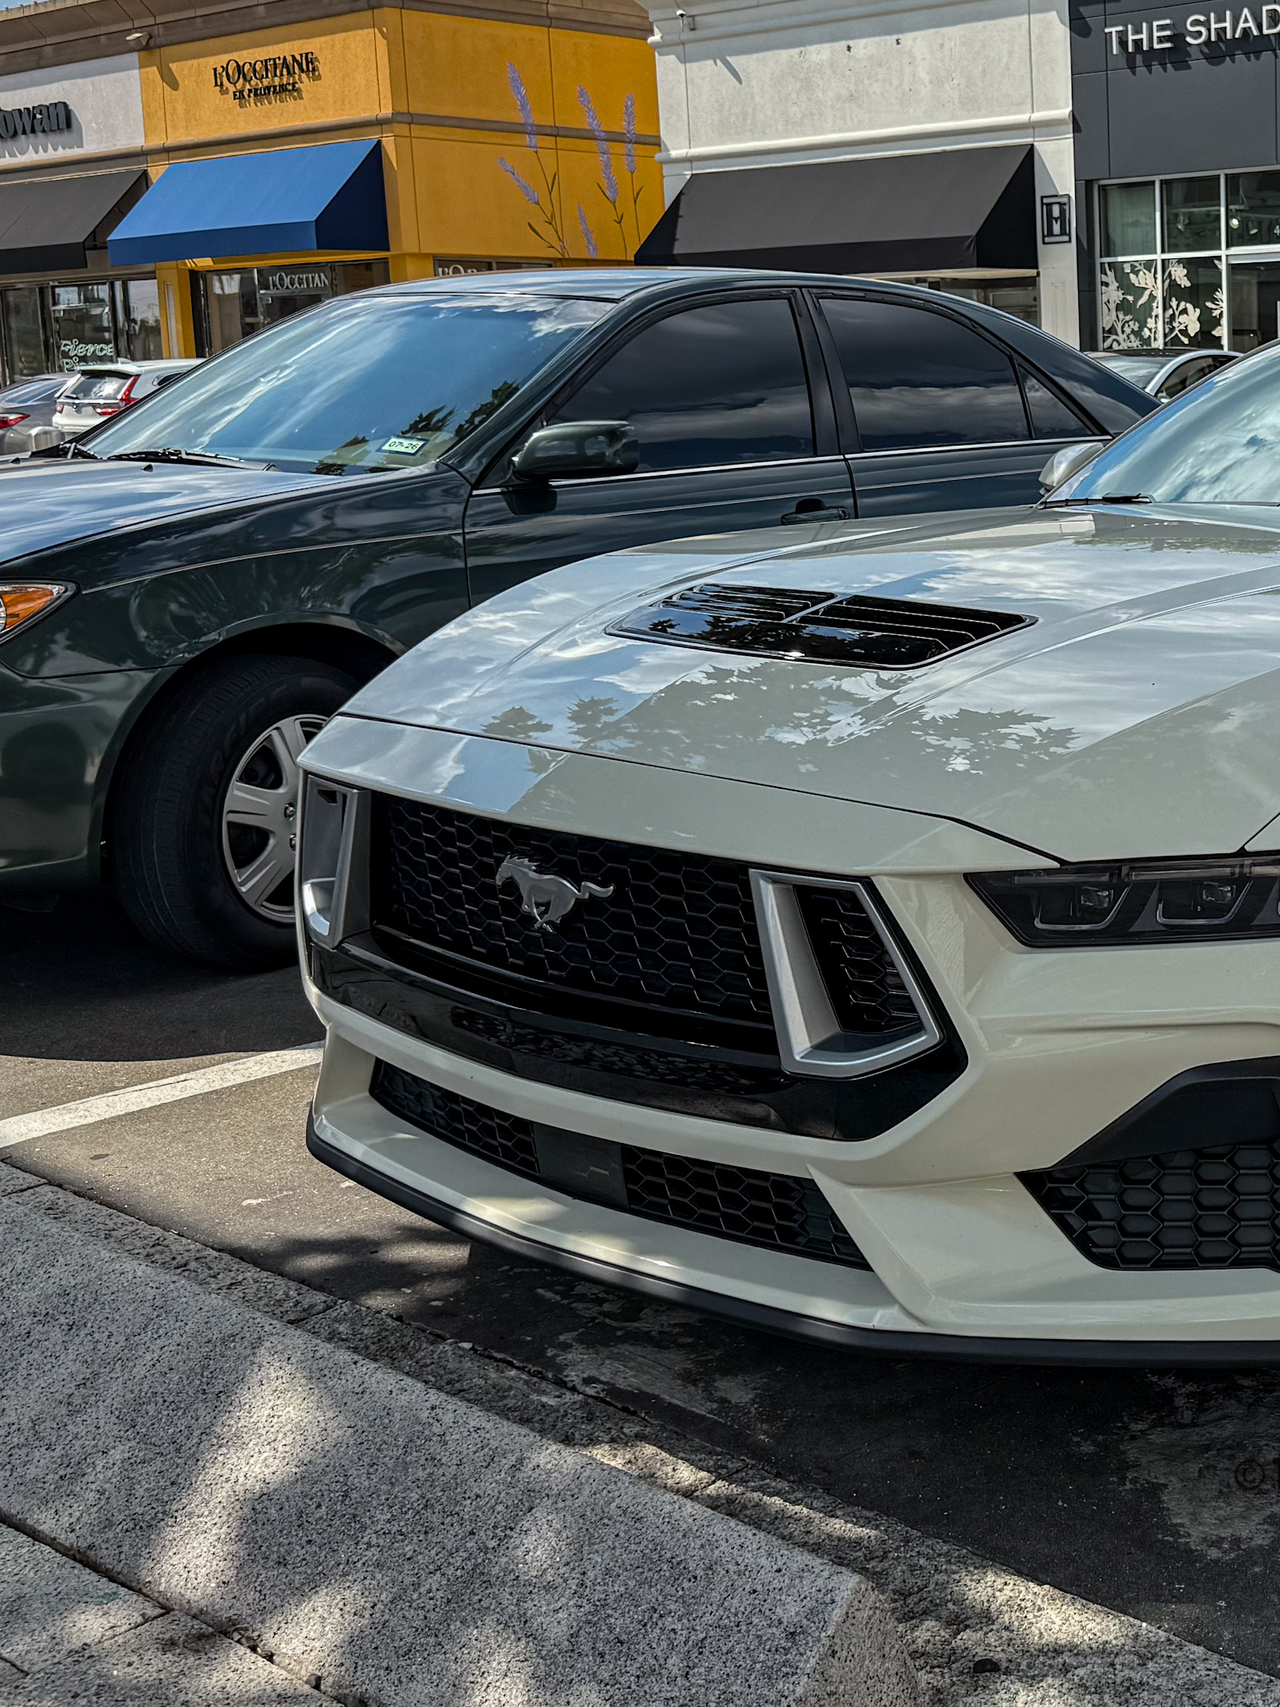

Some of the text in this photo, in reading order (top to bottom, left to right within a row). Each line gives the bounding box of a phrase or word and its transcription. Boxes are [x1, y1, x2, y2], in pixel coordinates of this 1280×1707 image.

[1104, 19, 1174, 55] THE
[213, 52, 316, 88] L'OCCITANE
[248, 82, 299, 98] PROVENCE
[0, 101, 69, 139] owan
